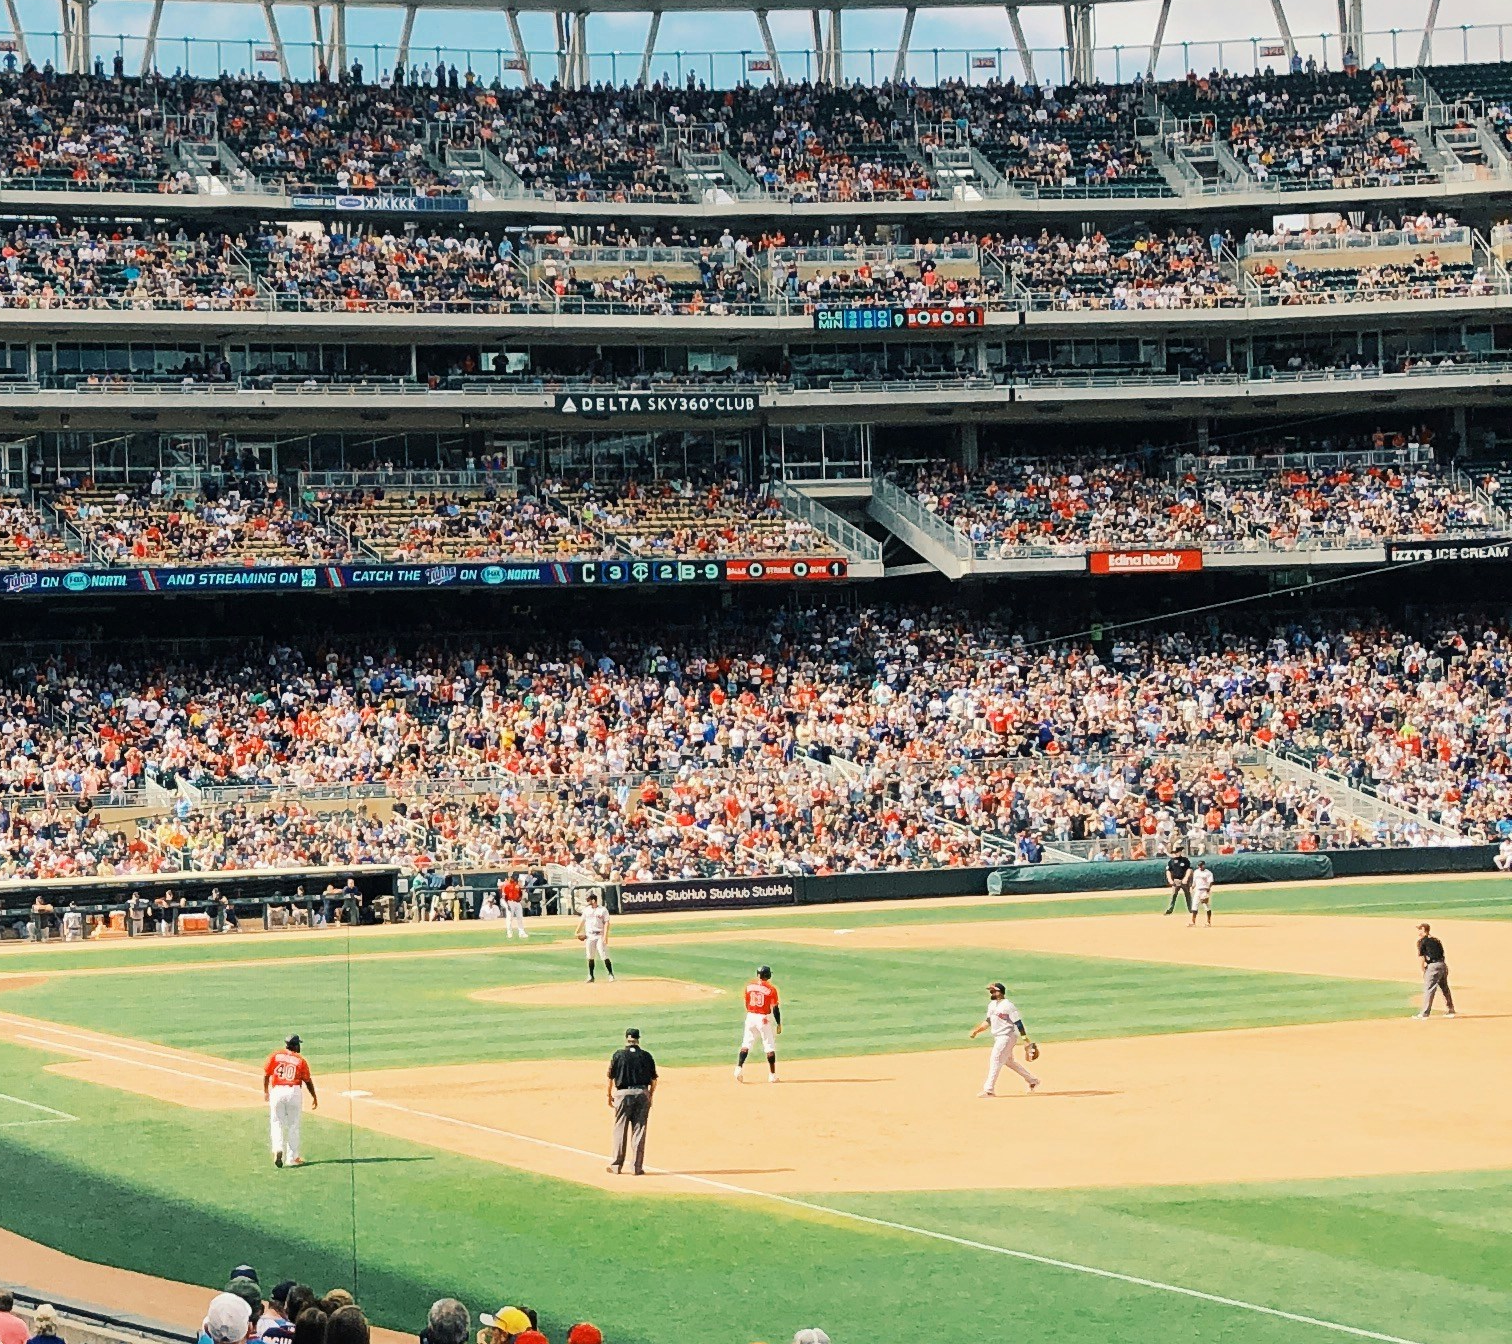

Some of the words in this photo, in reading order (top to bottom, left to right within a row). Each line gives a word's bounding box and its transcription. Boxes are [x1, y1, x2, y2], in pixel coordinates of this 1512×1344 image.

[818, 311, 842, 320] CLE
[818, 319, 843, 329] MIN
[581, 397, 642, 412] DELTA
[1436, 548, 1458, 560] ICE
[1460, 546, 1510, 560] CREAM
[1108, 552, 1141, 567] Edina
[1142, 553, 1182, 569] Realty
[352, 570, 392, 582] CATCH
[397, 569, 421, 581] THE
[460, 569, 477, 580] ON
[582, 563, 595, 582] C
[609, 565, 621, 579] 3
[660, 565, 673, 579] 2
[831, 562, 839, 576] 1
[2, 572, 38, 593] Twins
[41, 576, 60, 587] ON
[167, 573, 194, 585] AND
[198, 572, 277, 585] STREAMING
[279, 572, 298, 583] ON
[621, 890, 664, 904] StubHub
[665, 888, 707, 901] StubHub
[709, 886, 751, 900] StubHub
[751, 884, 793, 898] StubHub
[273, 1063, 296, 1082] 40
